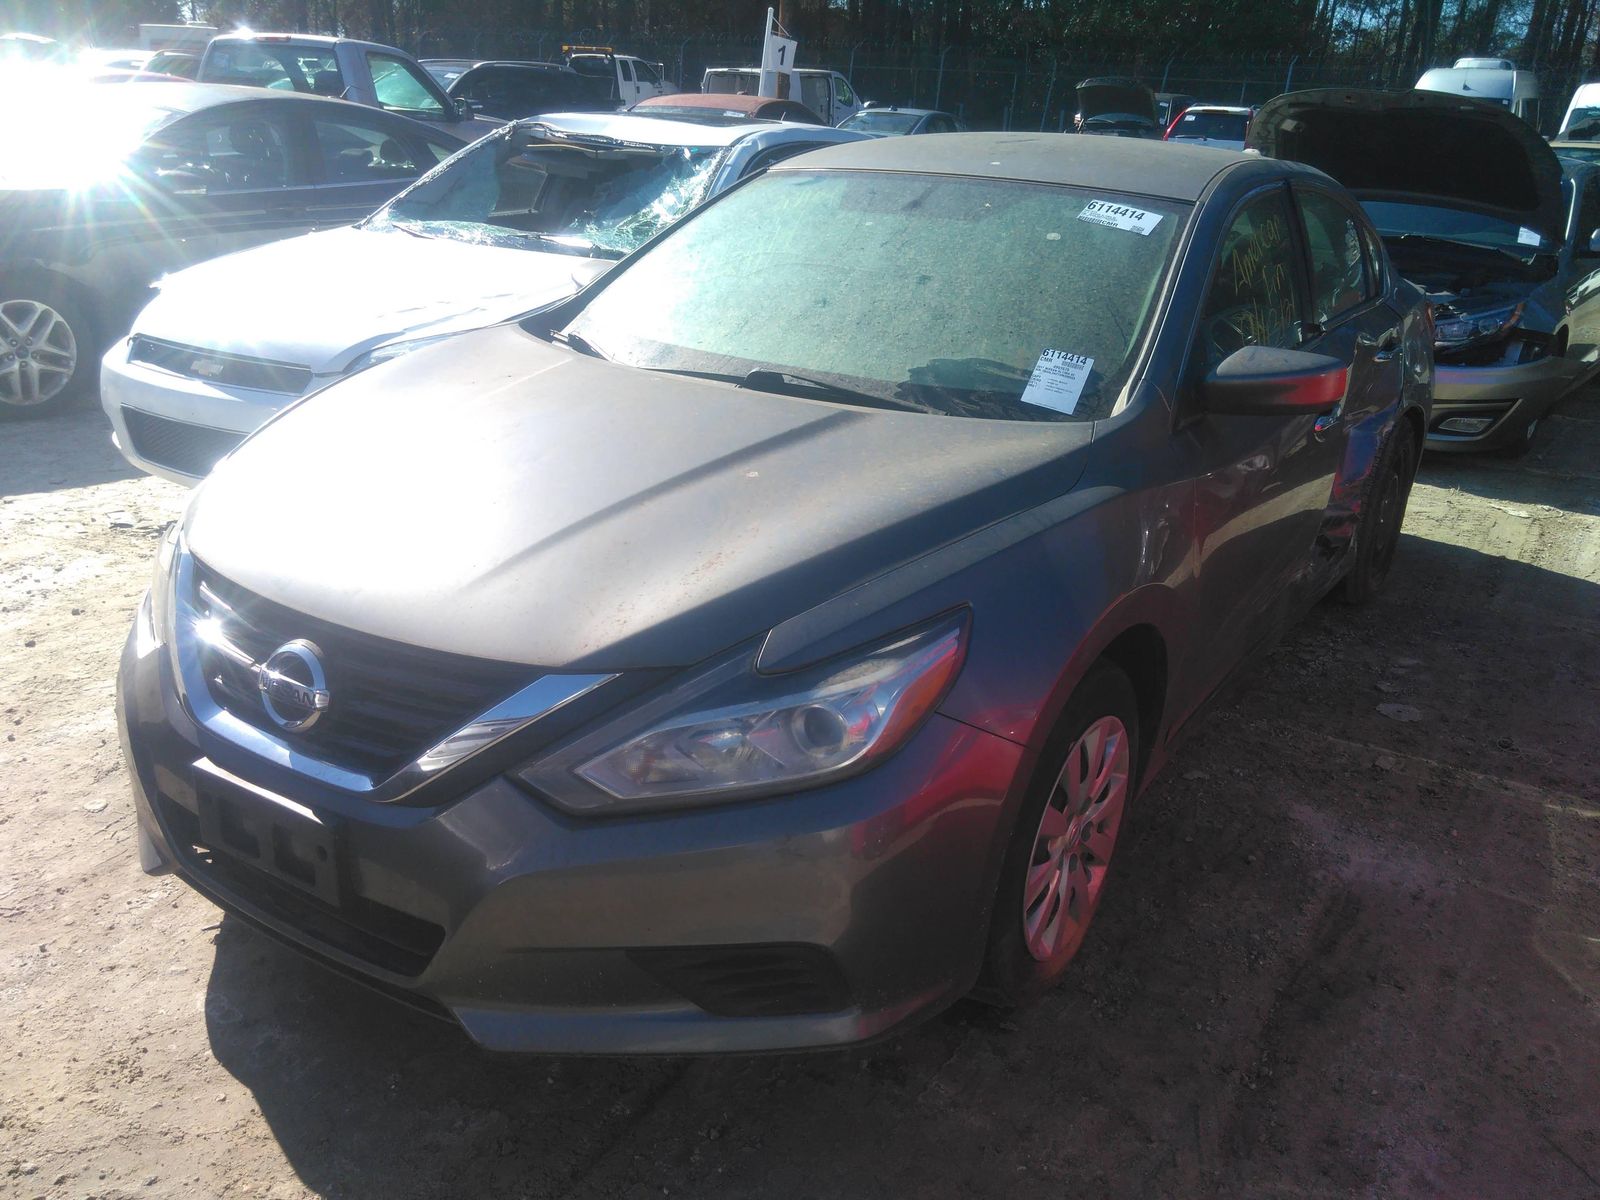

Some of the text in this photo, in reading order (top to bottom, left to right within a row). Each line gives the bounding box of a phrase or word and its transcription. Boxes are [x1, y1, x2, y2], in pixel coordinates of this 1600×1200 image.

[778, 45, 786, 66] 1
[1087, 201, 1146, 221] 6114414
[1042, 348, 1088, 365] 6114414
